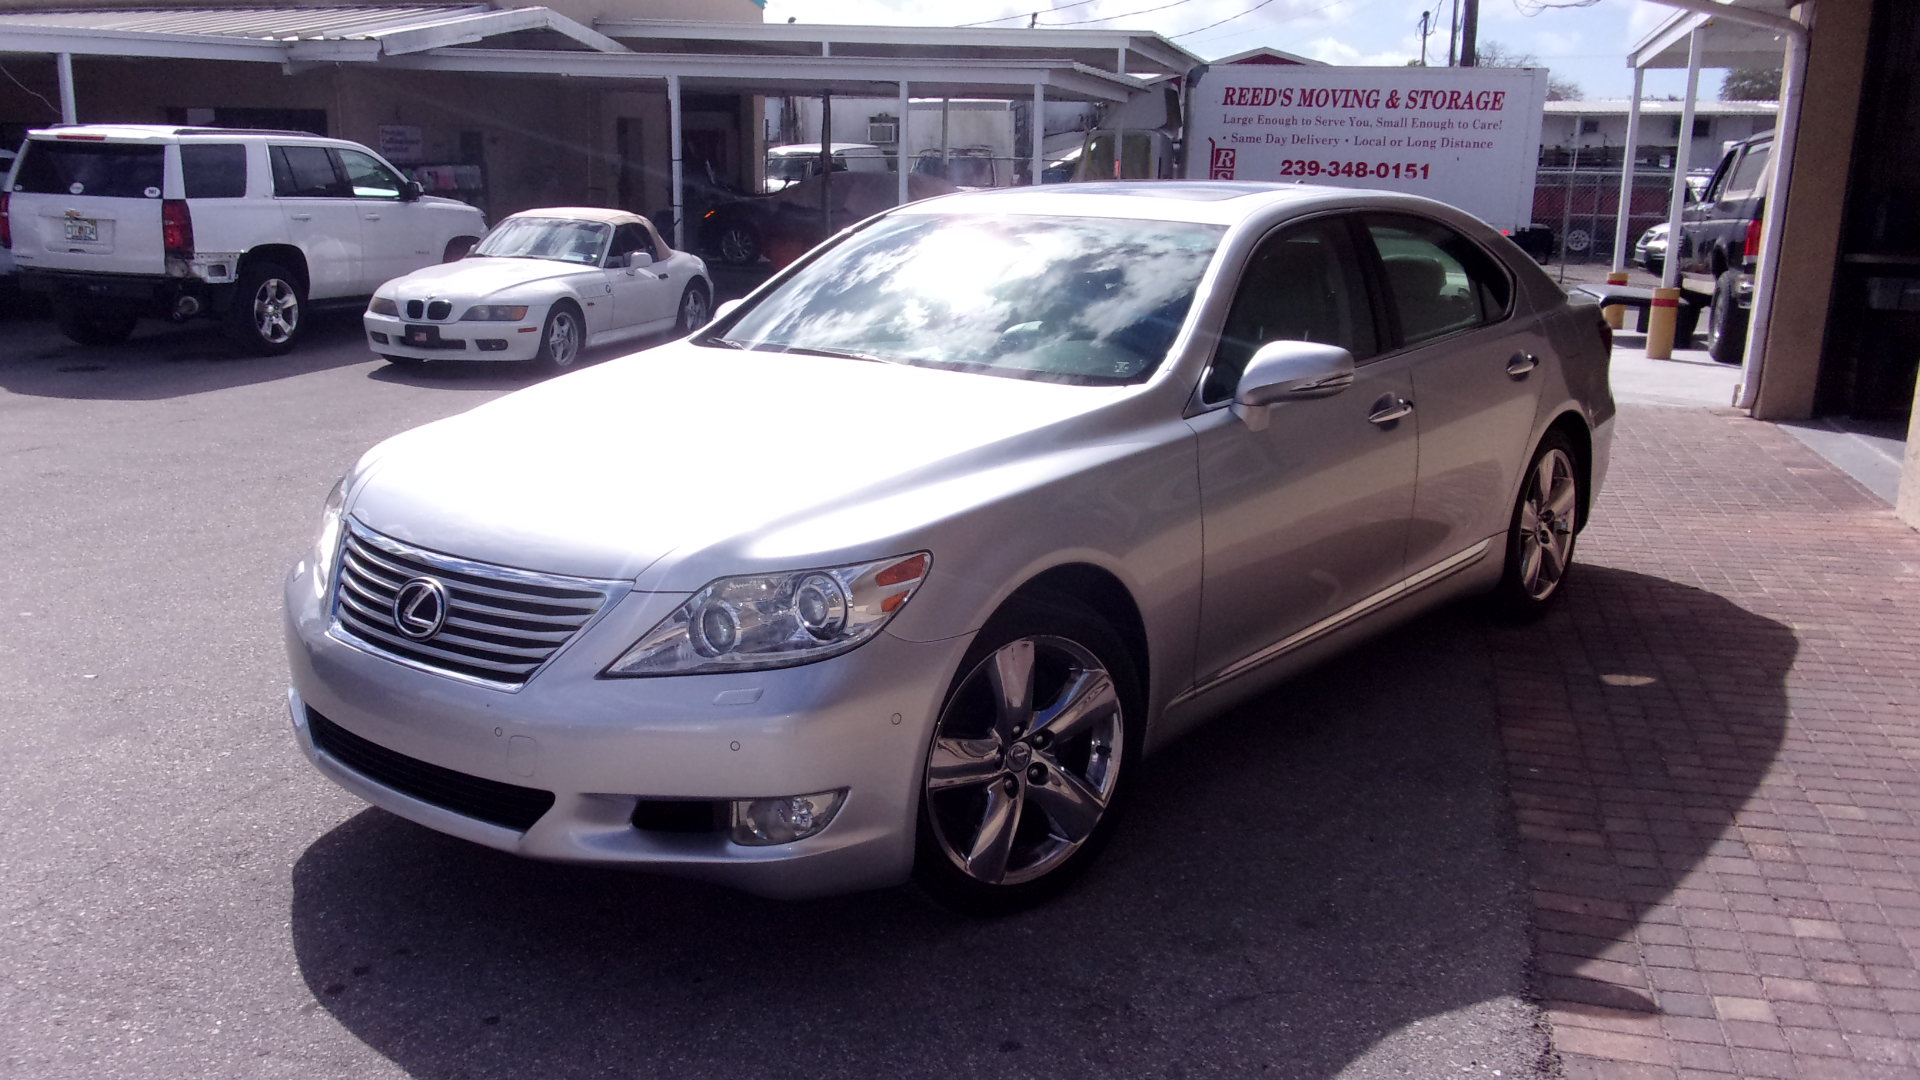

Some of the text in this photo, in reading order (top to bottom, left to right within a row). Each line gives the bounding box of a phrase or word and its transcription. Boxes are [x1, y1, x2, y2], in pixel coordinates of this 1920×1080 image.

[1221, 86, 1506, 111] REED'S MOVING & STORAGE
[1223, 113, 1503, 131] Large Enough to Serve You, Small Enough to Care!
[1231, 132, 1493, 149] Same Day Delivery Local or Long Distance
[1216, 150, 1234, 167] R
[1280, 159, 1430, 180] 239-348-0151
